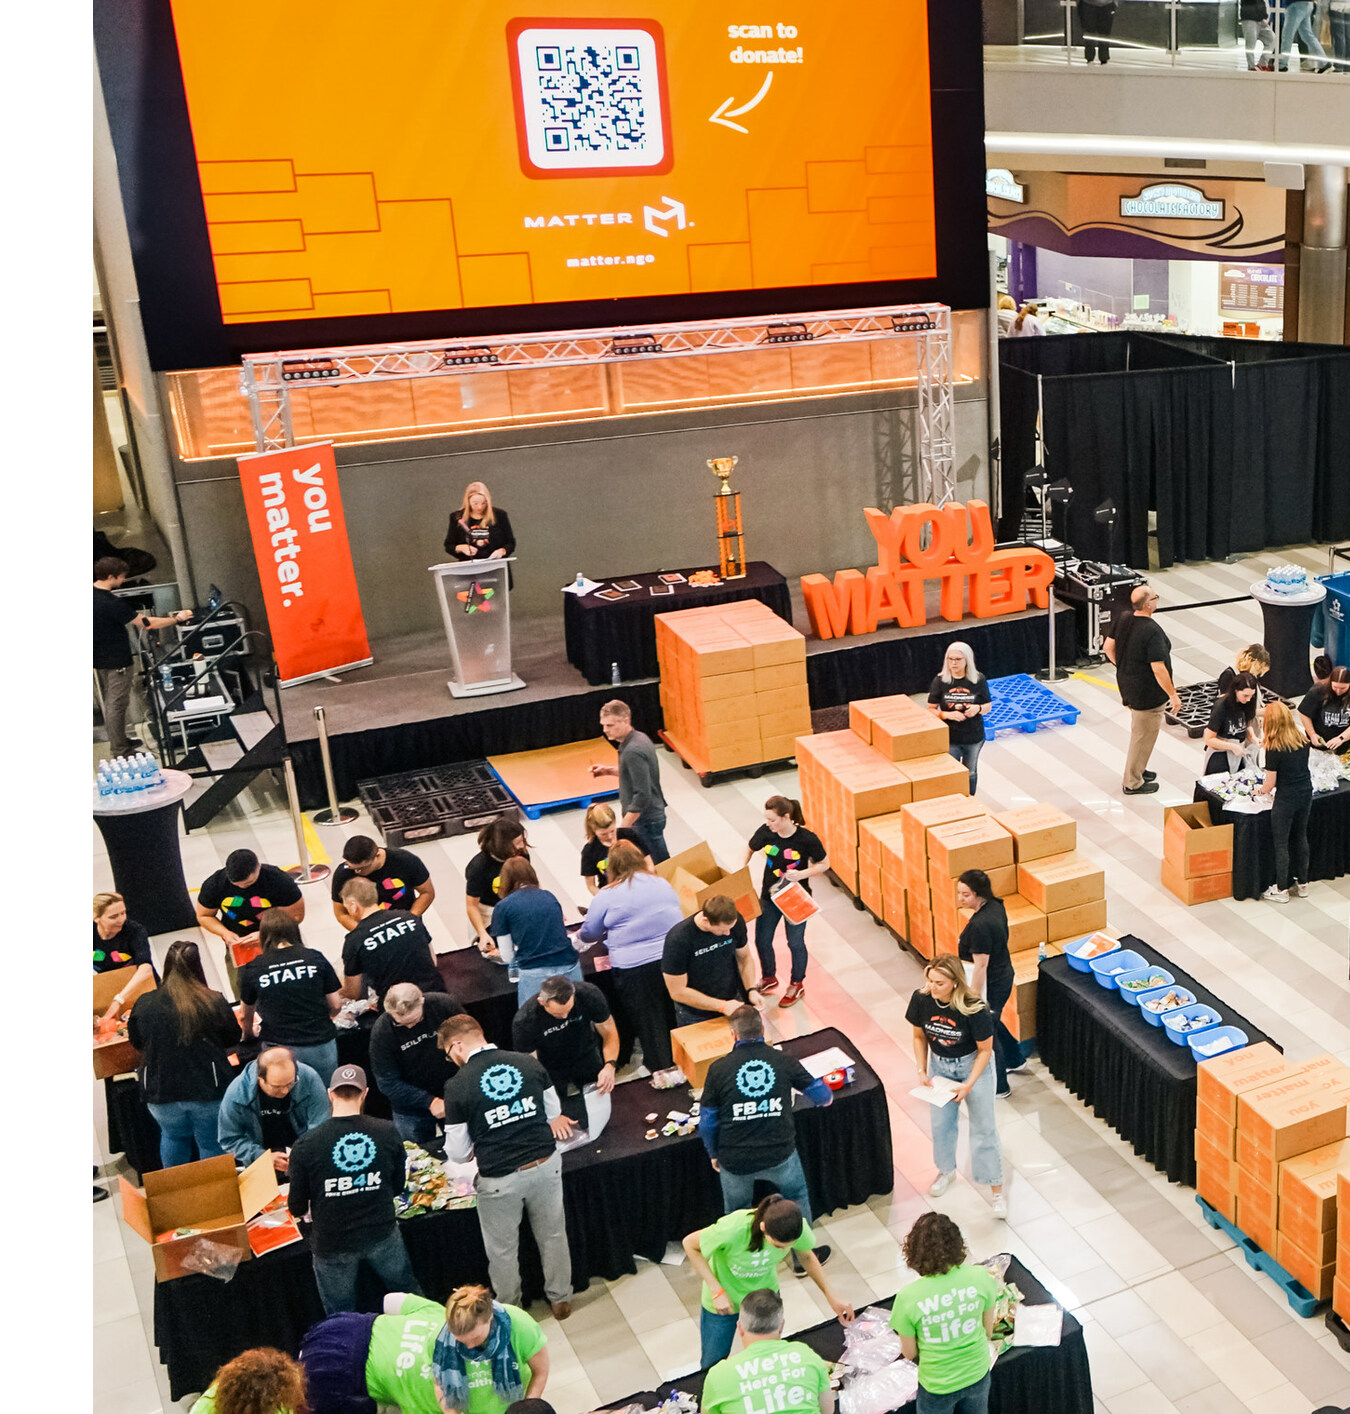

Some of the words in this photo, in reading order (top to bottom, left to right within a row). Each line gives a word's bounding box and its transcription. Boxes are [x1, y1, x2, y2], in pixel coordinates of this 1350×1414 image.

[727, 24, 772, 39] scan
[776, 22, 798, 39] to
[729, 46, 804, 63] donate!
[523, 212, 633, 228] MATTER
[1125, 199, 1176, 215] CHOCOLATE
[1177, 201, 1219, 218] FACTORY
[566, 253, 655, 268] matter.ngo
[292, 463, 332, 533] you
[259, 472, 304, 607] matter.
[863, 499, 996, 572] YOU
[800, 547, 1056, 640] MATTER
[364, 919, 416, 951] STAFF
[258, 965, 317, 988] STAFF
[924, 1023, 962, 1037] MADNESS
[693, 1036, 733, 1053] mat
[1223, 1050, 1254, 1067] you
[1233, 1064, 1286, 1088] matter
[1256, 1078, 1310, 1102] matter
[484, 1096, 537, 1125] FB4K
[732, 1097, 783, 1117] FB4K
[1288, 1101, 1320, 1117] you
[324, 1171, 382, 1192] FB4K
[917, 1286, 978, 1316] We're
[921, 1309, 955, 1325] Here
[958, 1300, 980, 1316] For
[922, 1317, 981, 1344] Life.
[396, 1320, 429, 1377] Life.
[735, 1352, 802, 1380] We're
[740, 1374, 778, 1394] Here
[781, 1367, 806, 1383] For
[743, 1384, 812, 1414] Life.
